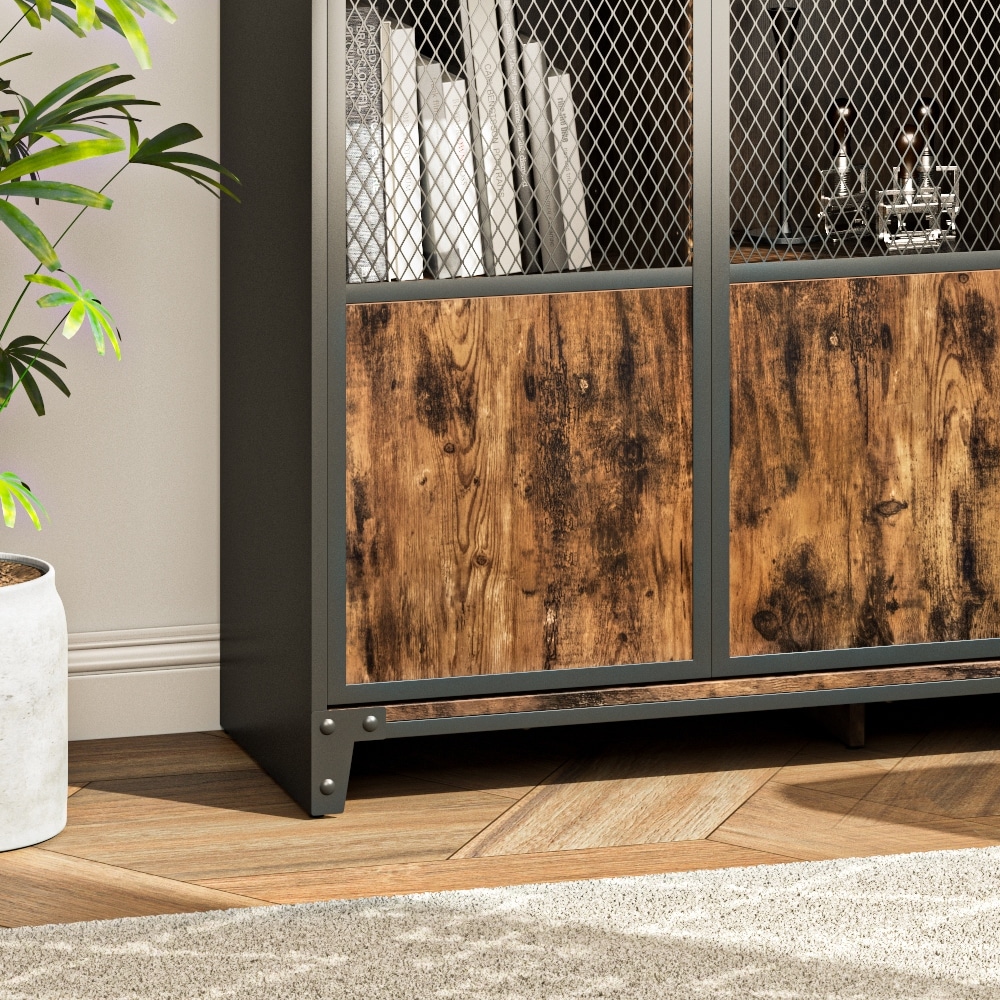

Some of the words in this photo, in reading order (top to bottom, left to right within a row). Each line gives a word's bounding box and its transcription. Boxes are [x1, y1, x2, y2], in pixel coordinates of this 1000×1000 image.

[357, 60, 368, 112] CLOFIL
[484, 64, 493, 86] CAR
[493, 149, 505, 197] POTRAITS
